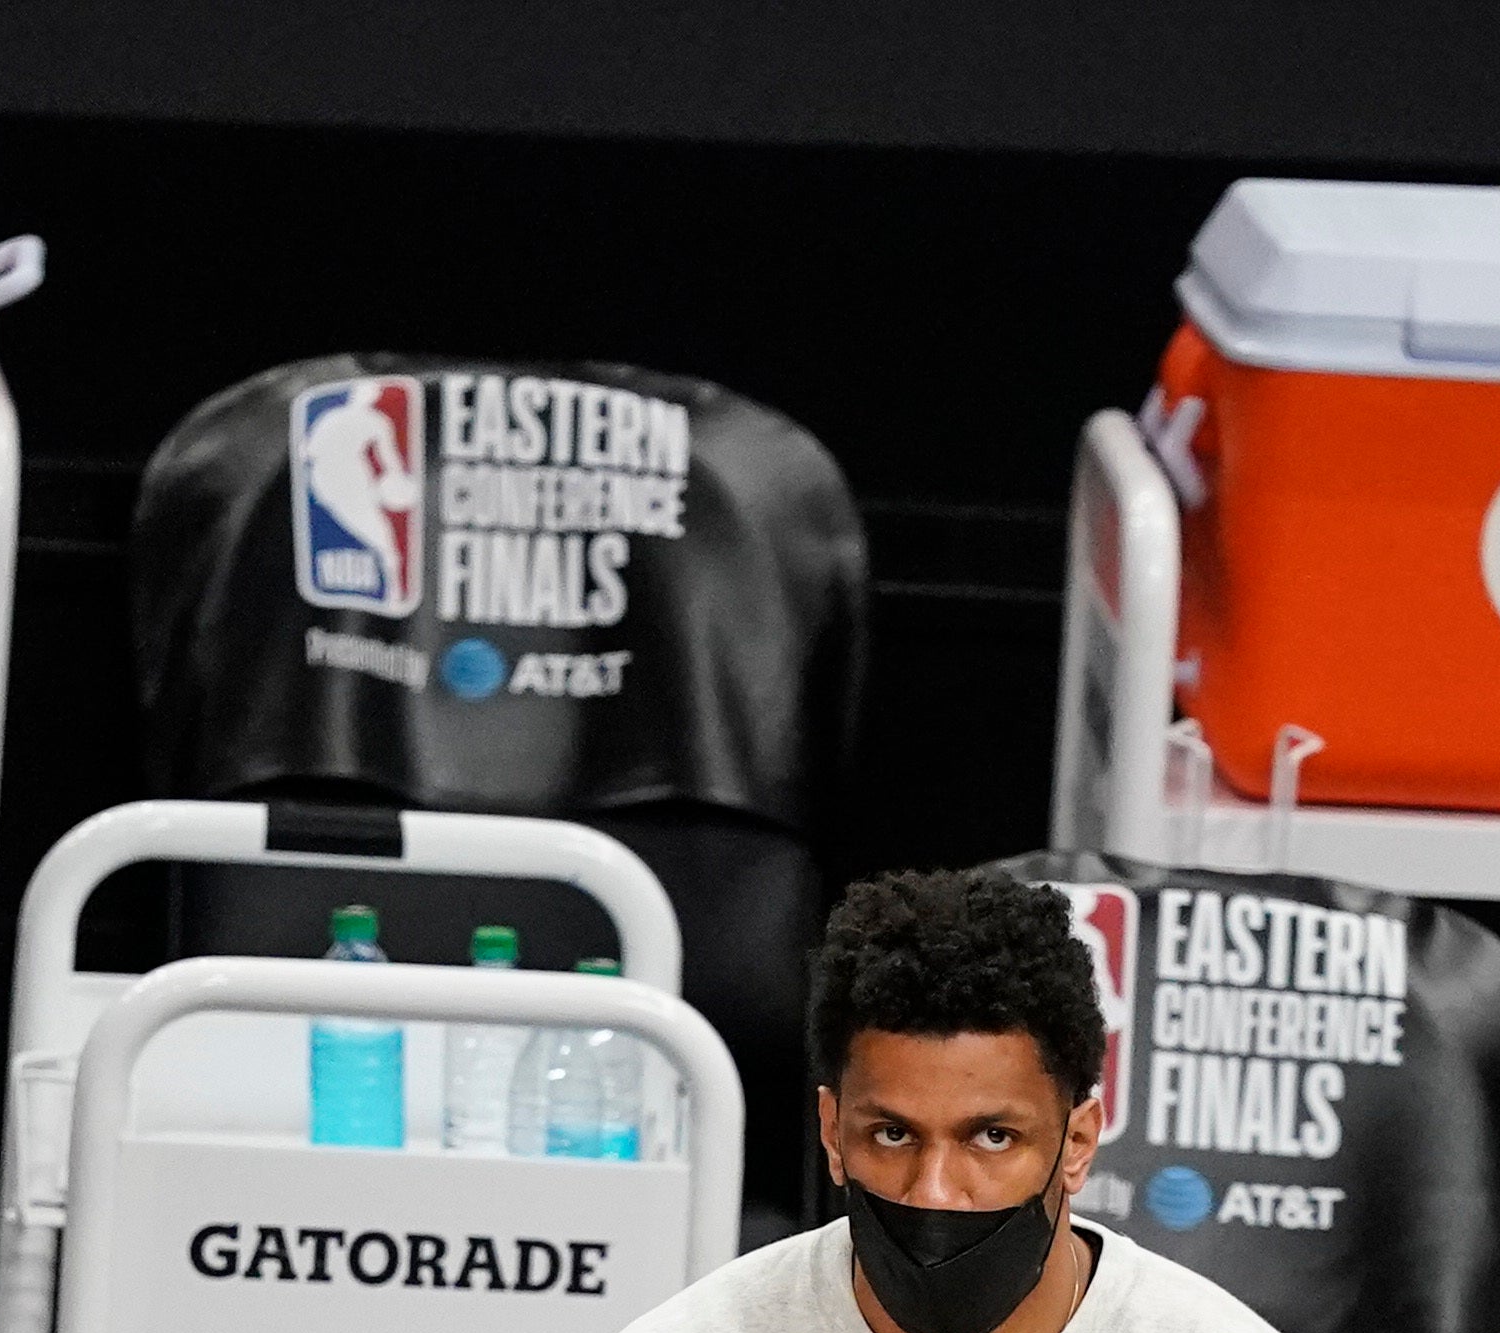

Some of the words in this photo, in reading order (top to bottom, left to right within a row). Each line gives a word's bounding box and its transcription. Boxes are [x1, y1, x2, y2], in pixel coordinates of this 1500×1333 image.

[439, 373, 690, 475] EASTERN
[439, 464, 688, 539] CONFERENCE
[437, 532, 630, 627] FINALS
[509, 651, 633, 698] AT&T
[1157, 888, 1408, 998] EASTERN
[1154, 982, 1407, 1067] CONFERENCE
[1147, 1050, 1346, 1160] FINALS
[1217, 1181, 1347, 1232] AT&T
[189, 1224, 610, 1297] GATORADE
